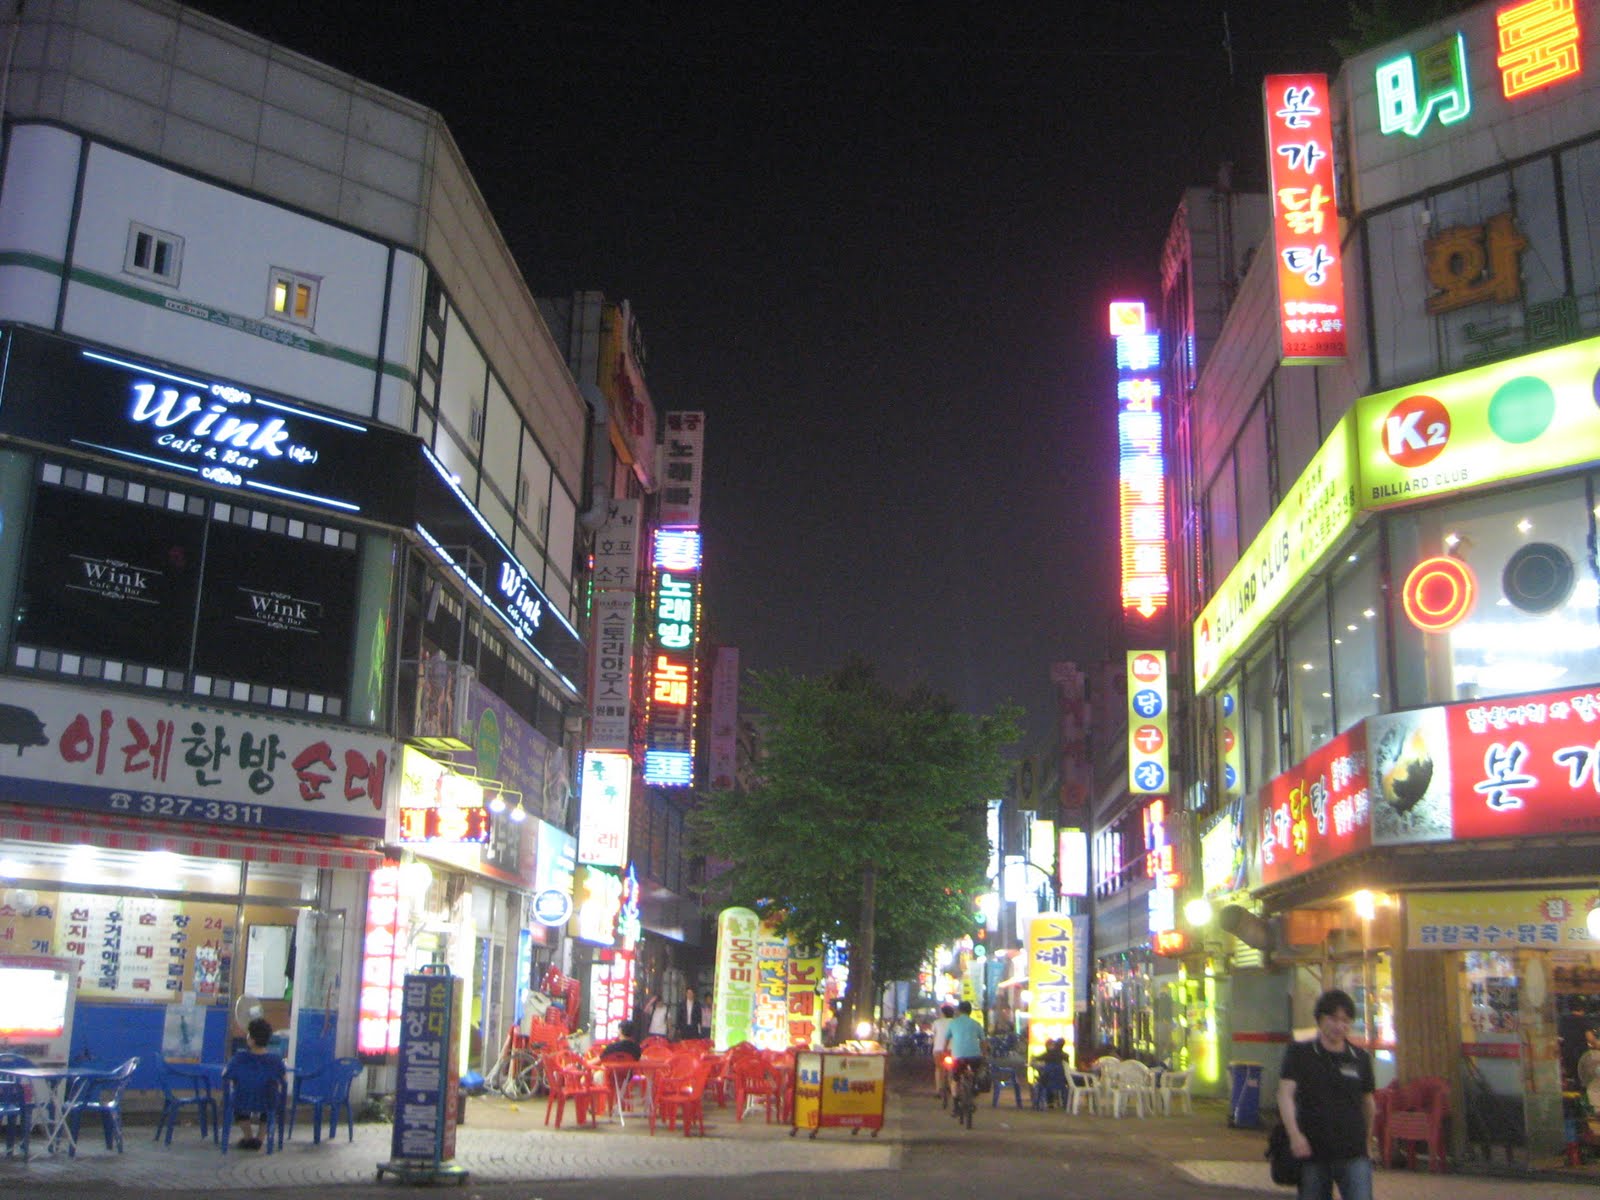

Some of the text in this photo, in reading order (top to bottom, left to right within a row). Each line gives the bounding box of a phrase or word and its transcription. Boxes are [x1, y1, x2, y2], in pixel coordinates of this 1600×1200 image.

[132, 383, 289, 457] Wink
[1385, 411, 1447, 457] K2
[157, 433, 202, 453] Cafe
[222, 449, 259, 468] Bar
[1371, 467, 1470, 501] BILLIARD CLUB
[598, 539, 633, 556] 호프
[1261, 531, 1290, 589] CLUB
[84, 561, 148, 589] Wink
[500, 561, 542, 628] Wink
[597, 566, 631, 585] 소주
[251, 595, 308, 620] Wink
[657, 572, 694, 649] 노래방
[600, 612, 625, 701] 스토리하우스
[1136, 692, 1162, 788] 당구장
[140, 794, 264, 825] 327-3311
